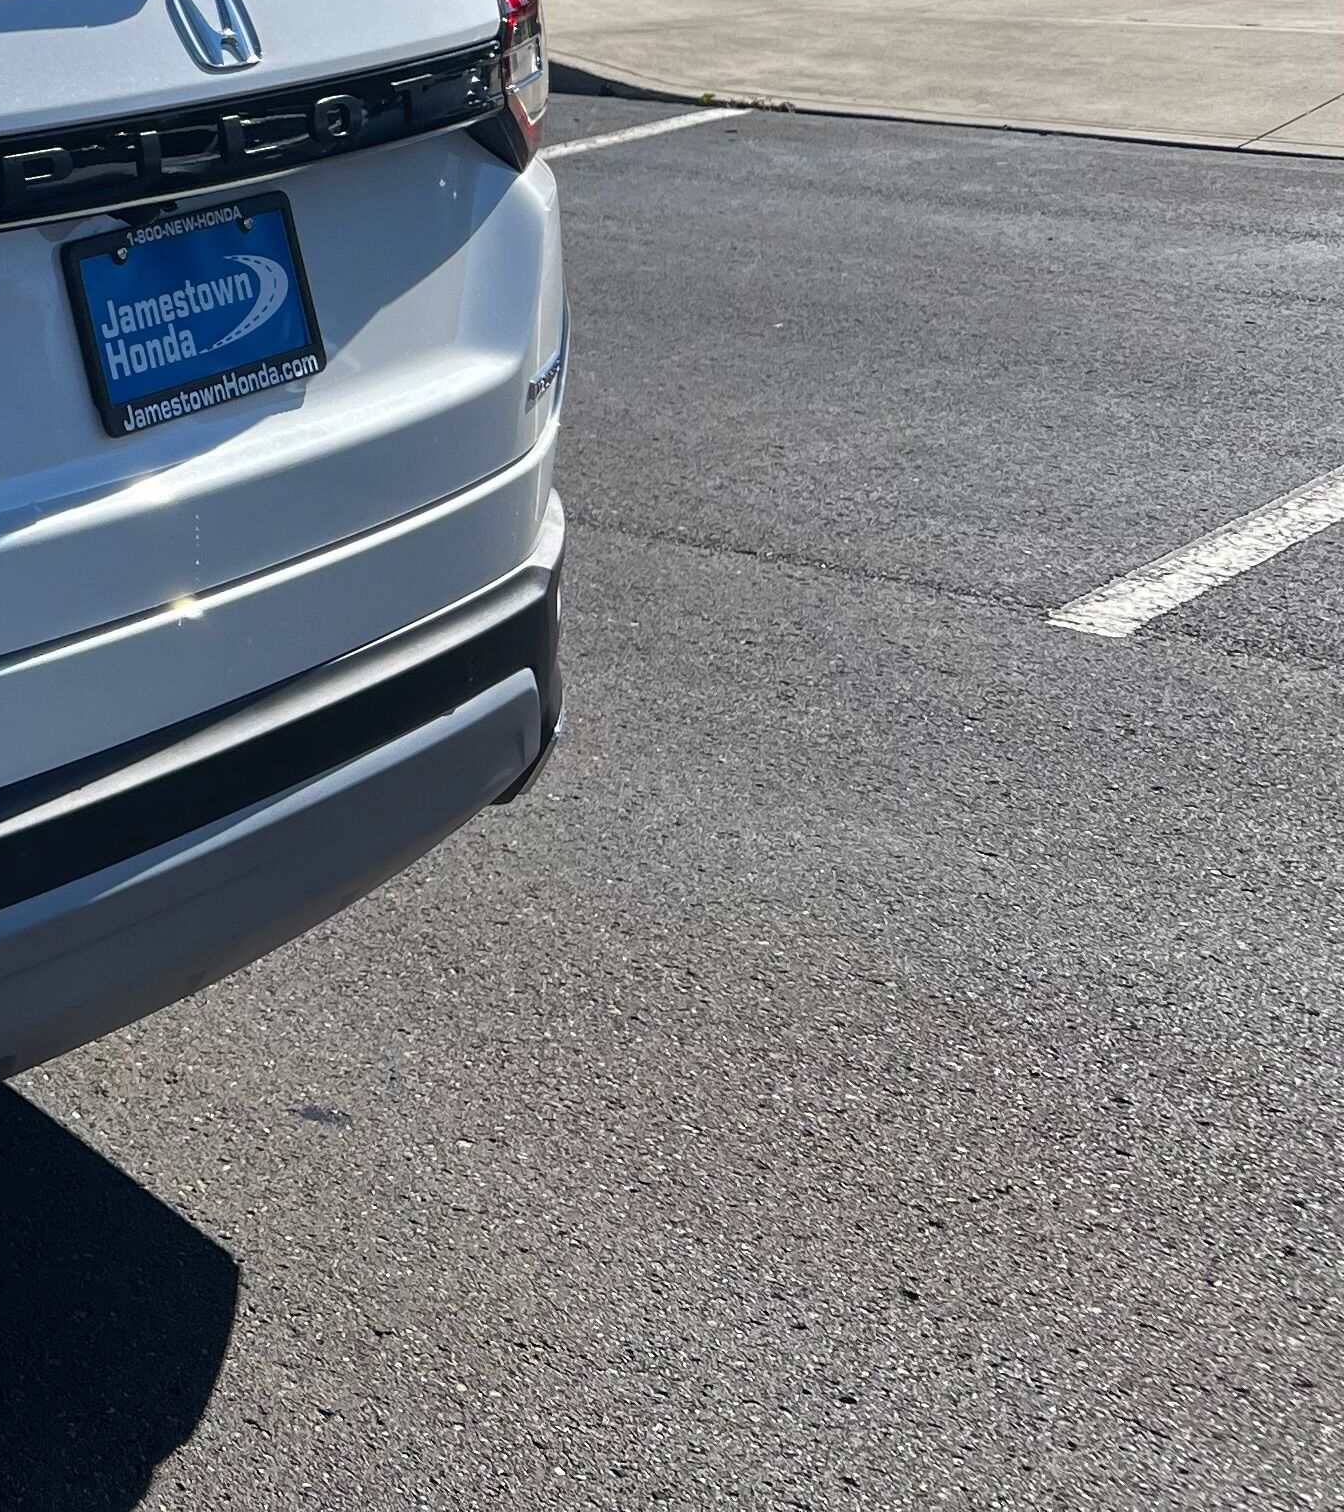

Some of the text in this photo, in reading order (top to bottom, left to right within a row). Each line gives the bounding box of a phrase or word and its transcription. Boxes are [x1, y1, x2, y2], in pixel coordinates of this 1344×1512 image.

[3, 74, 435, 202] PILOT
[126, 205, 243, 247] 1-800-NEW-HONDA
[101, 272, 254, 340] Jamestown
[105, 322, 198, 381] Honda
[123, 354, 320, 432] JamestownHonda.com
